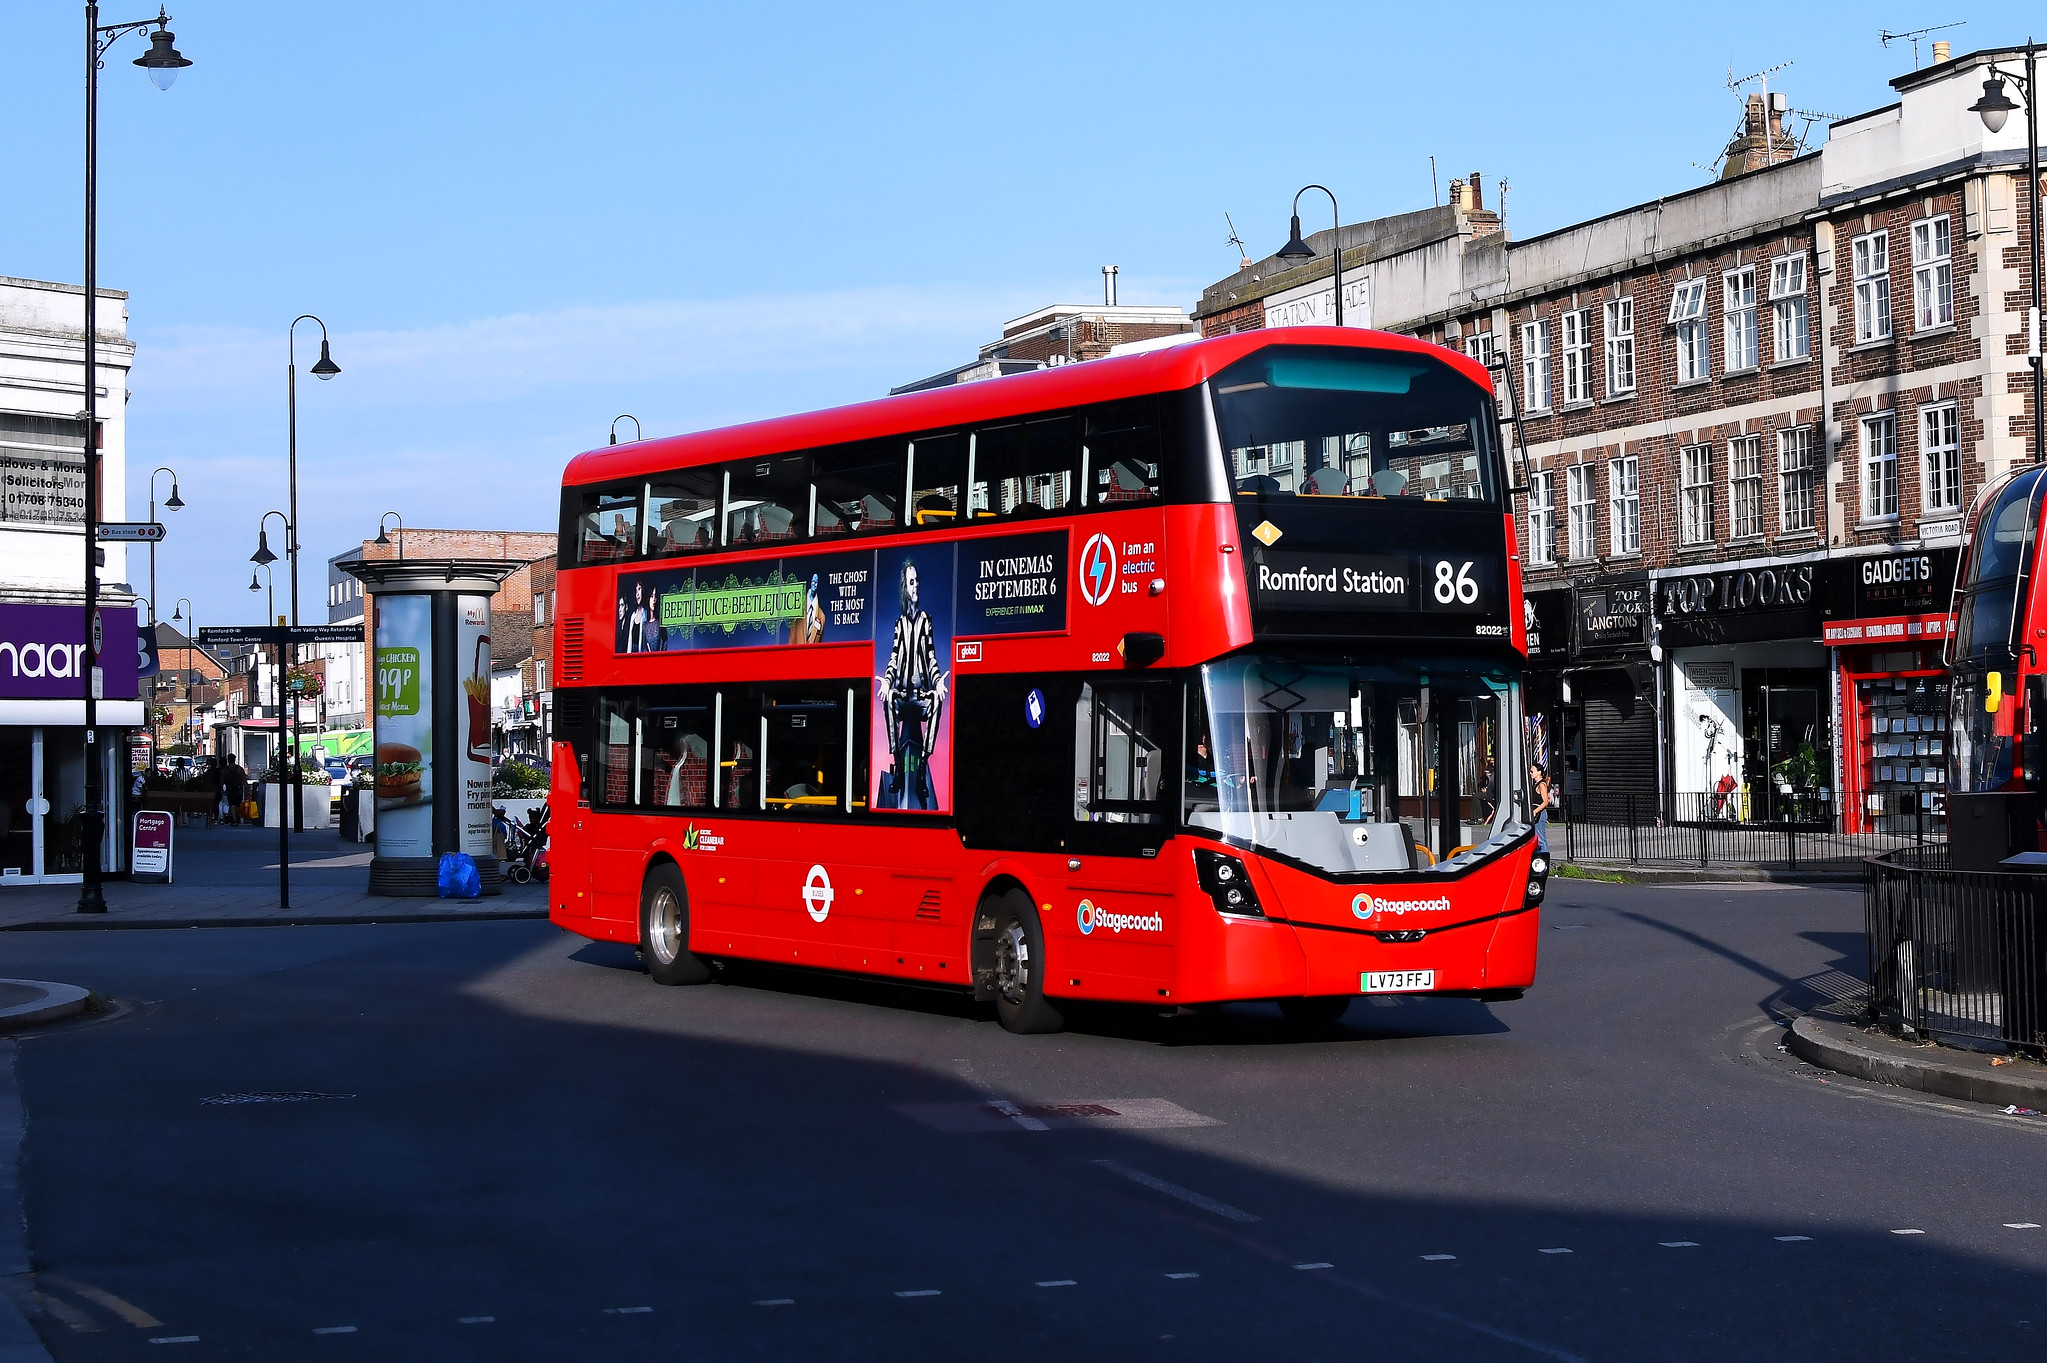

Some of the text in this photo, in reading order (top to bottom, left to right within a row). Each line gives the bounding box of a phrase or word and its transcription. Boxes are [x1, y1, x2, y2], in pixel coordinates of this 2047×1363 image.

[1270, 282, 1365, 327] STATION PAADE
[40, 460, 49, 471] &
[6, 474, 64, 490] Solicitors
[8, 493, 45, 506] 01708
[1921, 523, 1958, 536] VICTORIA ROAD
[1122, 541, 1155, 556] I am an
[979, 554, 1053, 579] IN CINEMAS
[1122, 559, 1155, 574] electric
[1862, 556, 1930, 585] GADGETS
[829, 570, 868, 584] THE GHOST
[1259, 560, 1479, 604] Romford Station 86
[839, 585, 857, 597] WITH
[975, 577, 1057, 600] SEPTEMBER 6
[1122, 579, 1138, 594] bus
[1663, 566, 1813, 615] TOP LOOKS
[1614, 590, 1641, 602] TOP
[731, 591, 801, 615] BEETLEJUICE
[830, 598, 865, 611] THE MOST
[1610, 602, 1649, 614] LOOKS
[985, 606, 1014, 617] EXPERIENCE
[1025, 604, 1044, 614] IMAX
[834, 612, 860, 625] IS BACK
[1587, 615, 1638, 631] LANGTONS
[1475, 625, 1502, 636] 82022
[386, 653, 416, 663] CHICKEN
[961, 645, 977, 659] global
[1091, 652, 1110, 662] 82022
[1710, 676, 1727, 684] STARS
[391, 701, 410, 711] Menu
[467, 780, 483, 789] Now
[467, 790, 479, 801] Fry
[467, 802, 485, 810] more
[139, 818, 165, 826] Mortgage
[1373, 896, 1450, 915] Stagecoach
[1095, 907, 1163, 933] Stagecoach
[1369, 972, 1432, 989] LV73 FFJ
